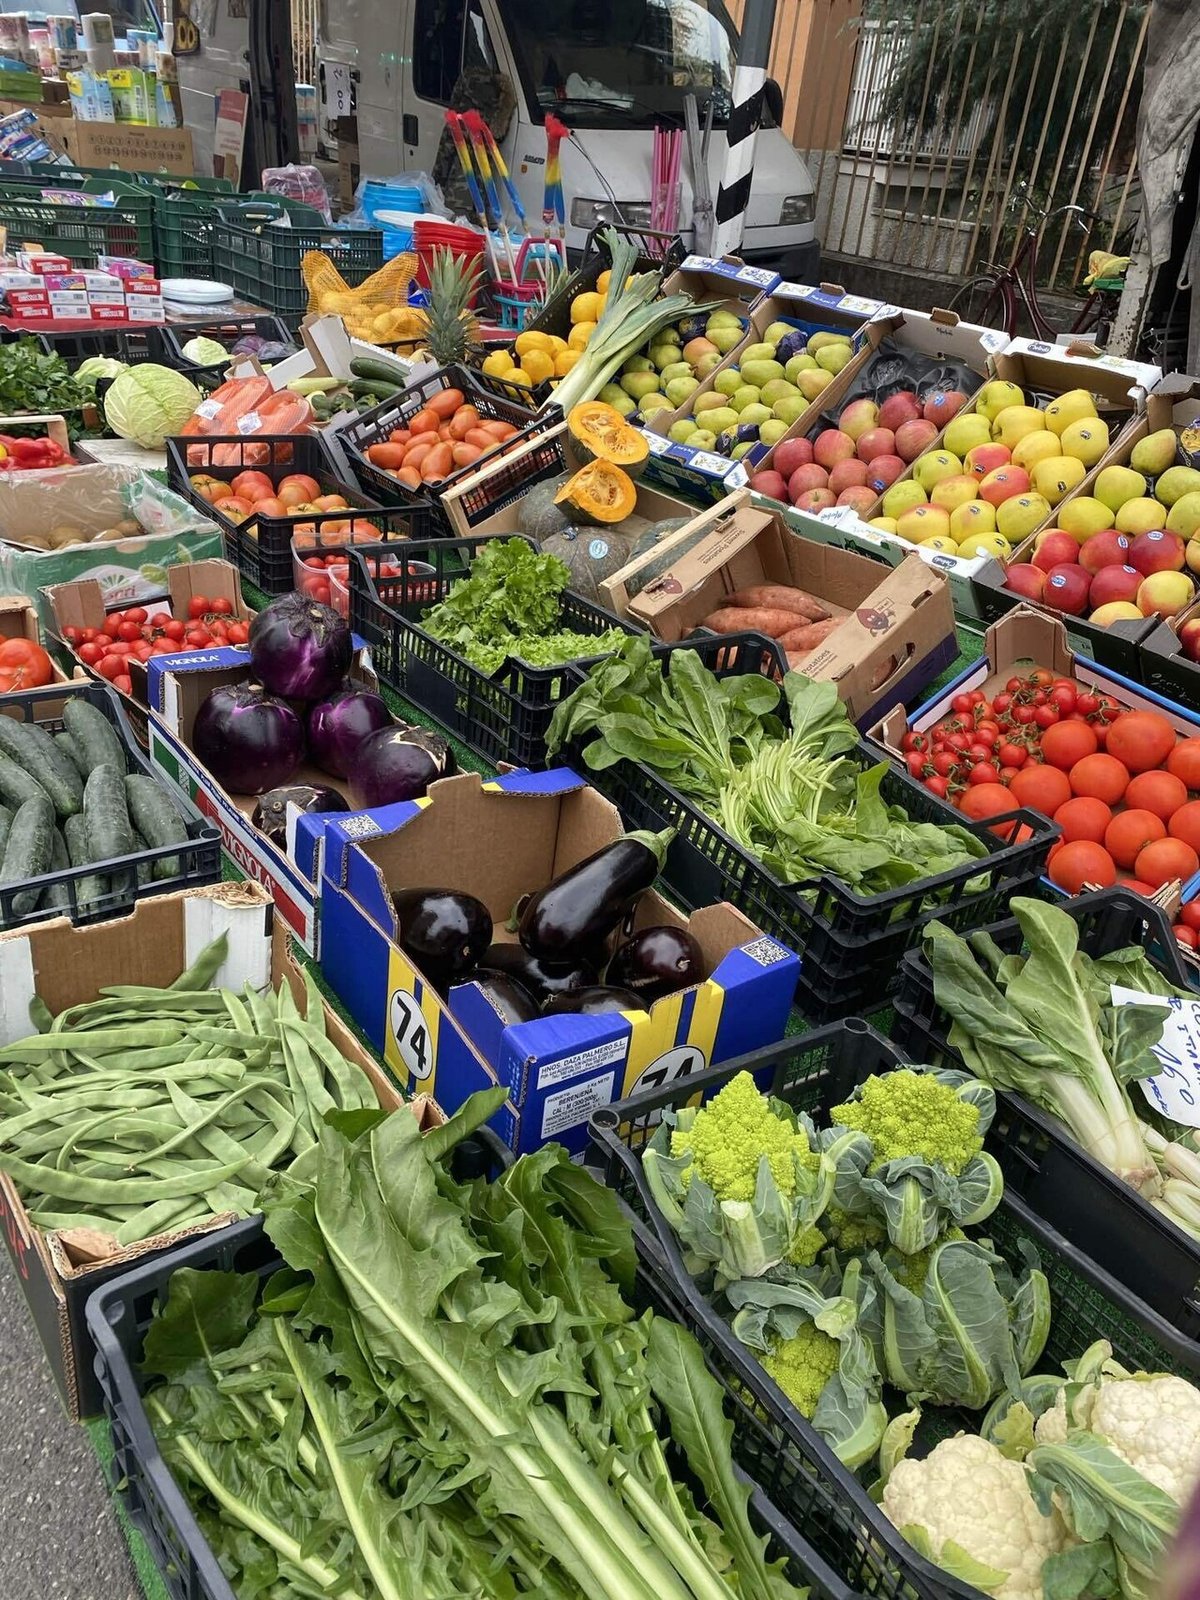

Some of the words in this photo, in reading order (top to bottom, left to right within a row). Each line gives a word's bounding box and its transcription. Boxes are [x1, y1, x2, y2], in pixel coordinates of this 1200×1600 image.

[164, 655, 219, 667] VIGNOLA
[801, 649, 831, 675] Potatoes
[219, 827, 275, 895] VIGNOLA
[396, 995, 427, 1072] 74
[563, 1056, 581, 1066] DAZA
[582, 1045, 613, 1060] PALMERO
[558, 1088, 593, 1105] BERENJENA
